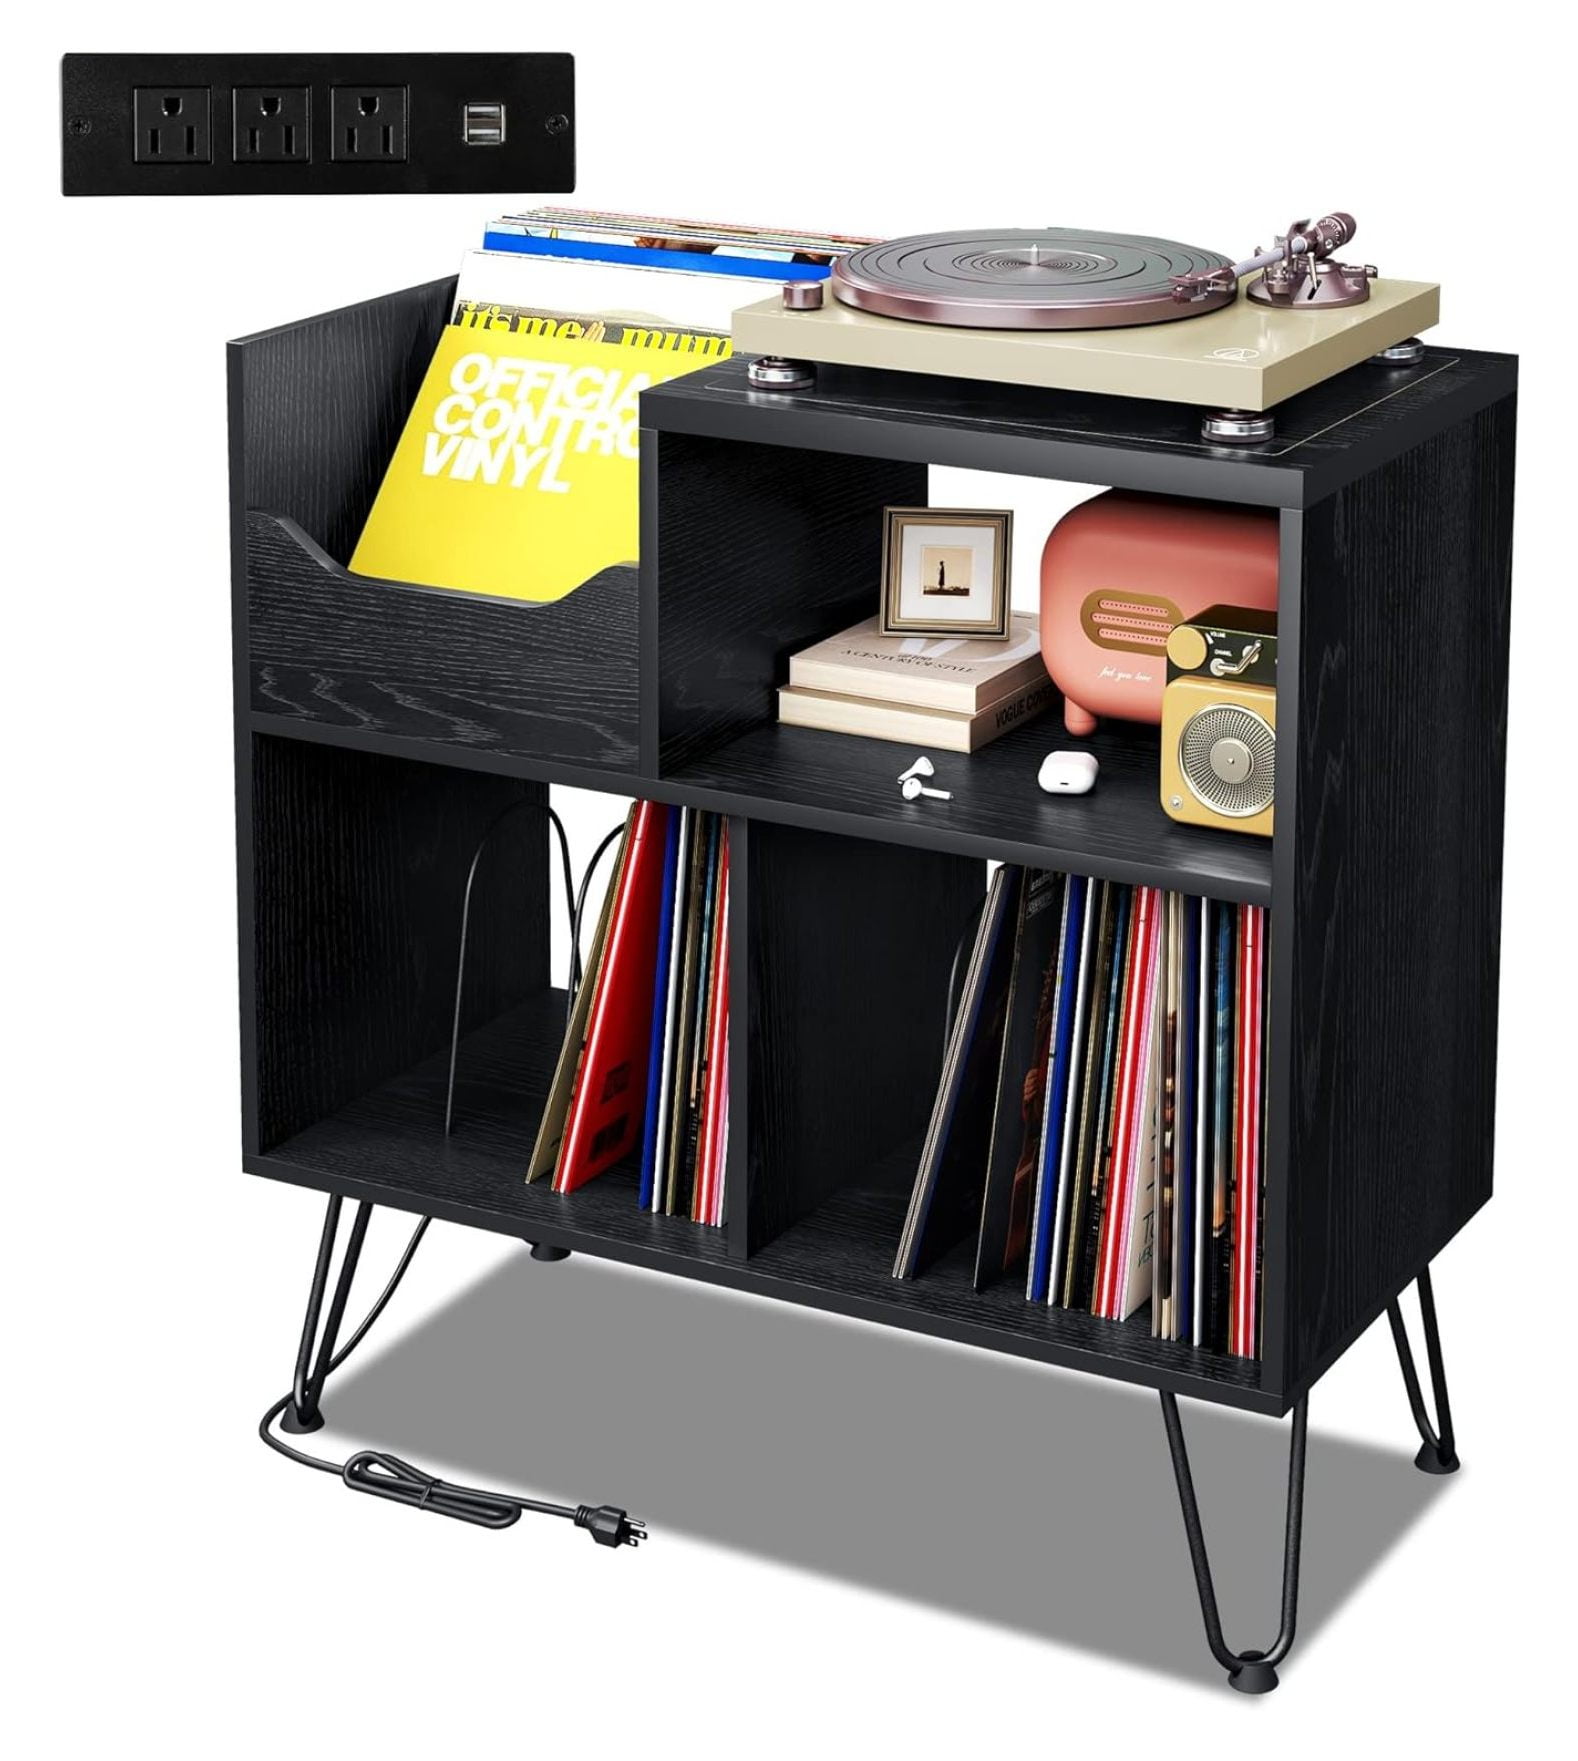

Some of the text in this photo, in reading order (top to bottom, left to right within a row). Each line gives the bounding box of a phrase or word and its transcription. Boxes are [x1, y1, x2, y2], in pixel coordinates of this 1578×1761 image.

[450, 353, 673, 409] OFFICIA
[421, 431, 573, 494] VINYL
[995, 697, 1026, 729] VOGUE
